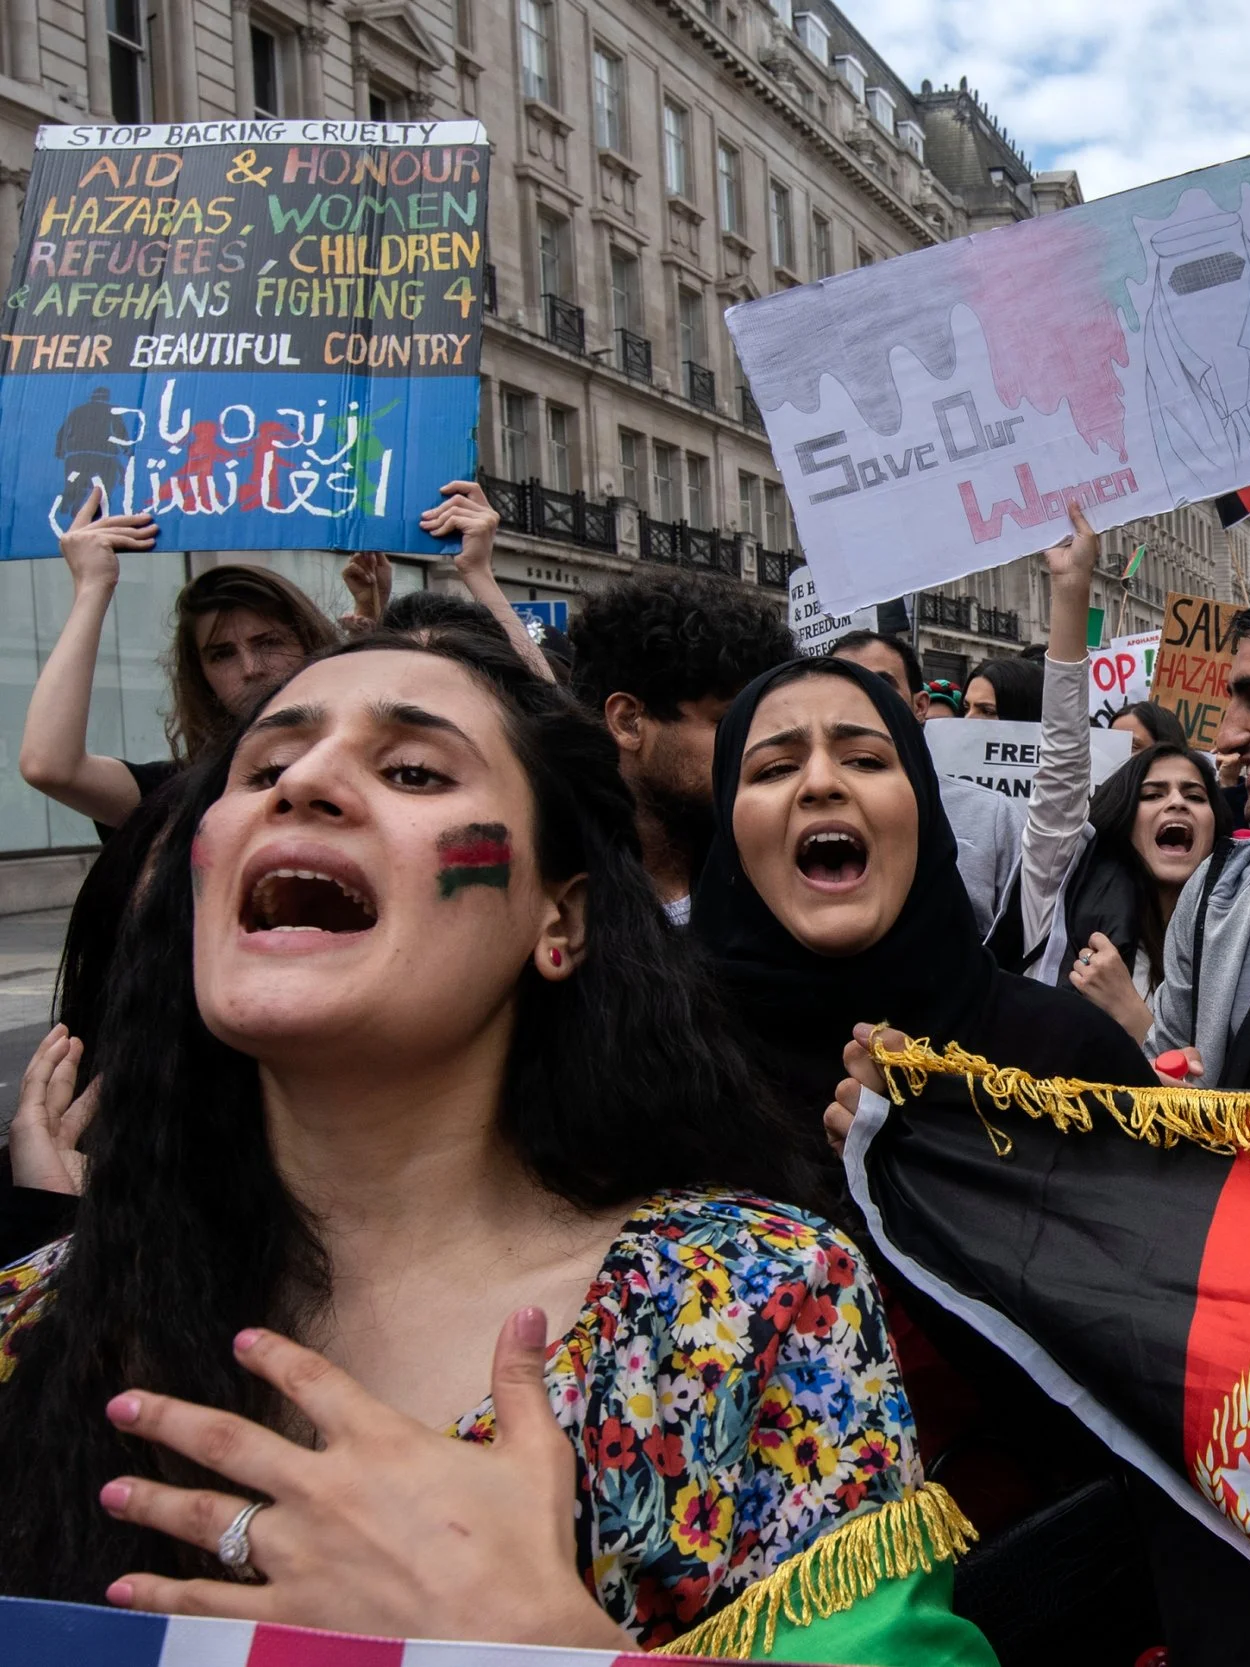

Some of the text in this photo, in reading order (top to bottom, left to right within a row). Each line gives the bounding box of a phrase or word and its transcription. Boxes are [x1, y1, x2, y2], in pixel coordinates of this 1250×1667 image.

[66, 121, 438, 146] STOP BACKING CRUELTY
[78, 147, 481, 188] AID & HONOUR
[38, 189, 477, 237] HAZARAS, WOMEN
[289, 231, 481, 275] CHILDREN
[32, 280, 231, 319] AFGHANS
[256, 277, 426, 319] FIGHTING
[443, 276, 477, 319] 4
[1, 331, 472, 370] THEIR BEAUTIFUL COUNTRY
[793, 390, 1025, 505] Save Our
[956, 463, 1140, 545] Women
[798, 616, 852, 641] FREEDOM
